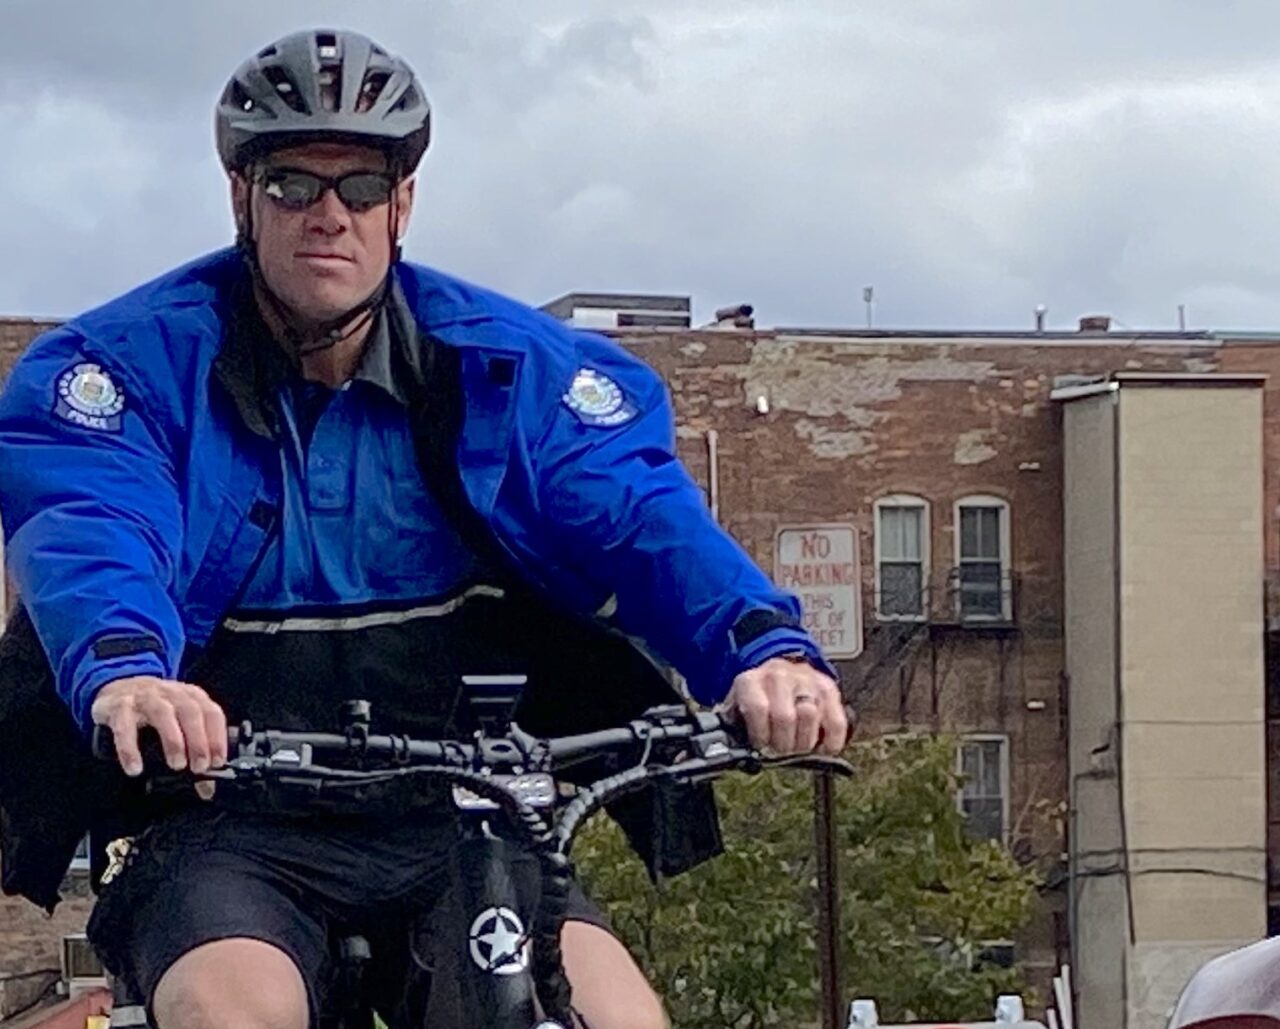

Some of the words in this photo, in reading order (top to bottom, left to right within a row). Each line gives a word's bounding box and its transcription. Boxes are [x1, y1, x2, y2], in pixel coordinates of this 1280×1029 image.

[801, 535, 831, 558] NO
[782, 564, 853, 586] PARKING
[828, 611, 846, 626] OF
